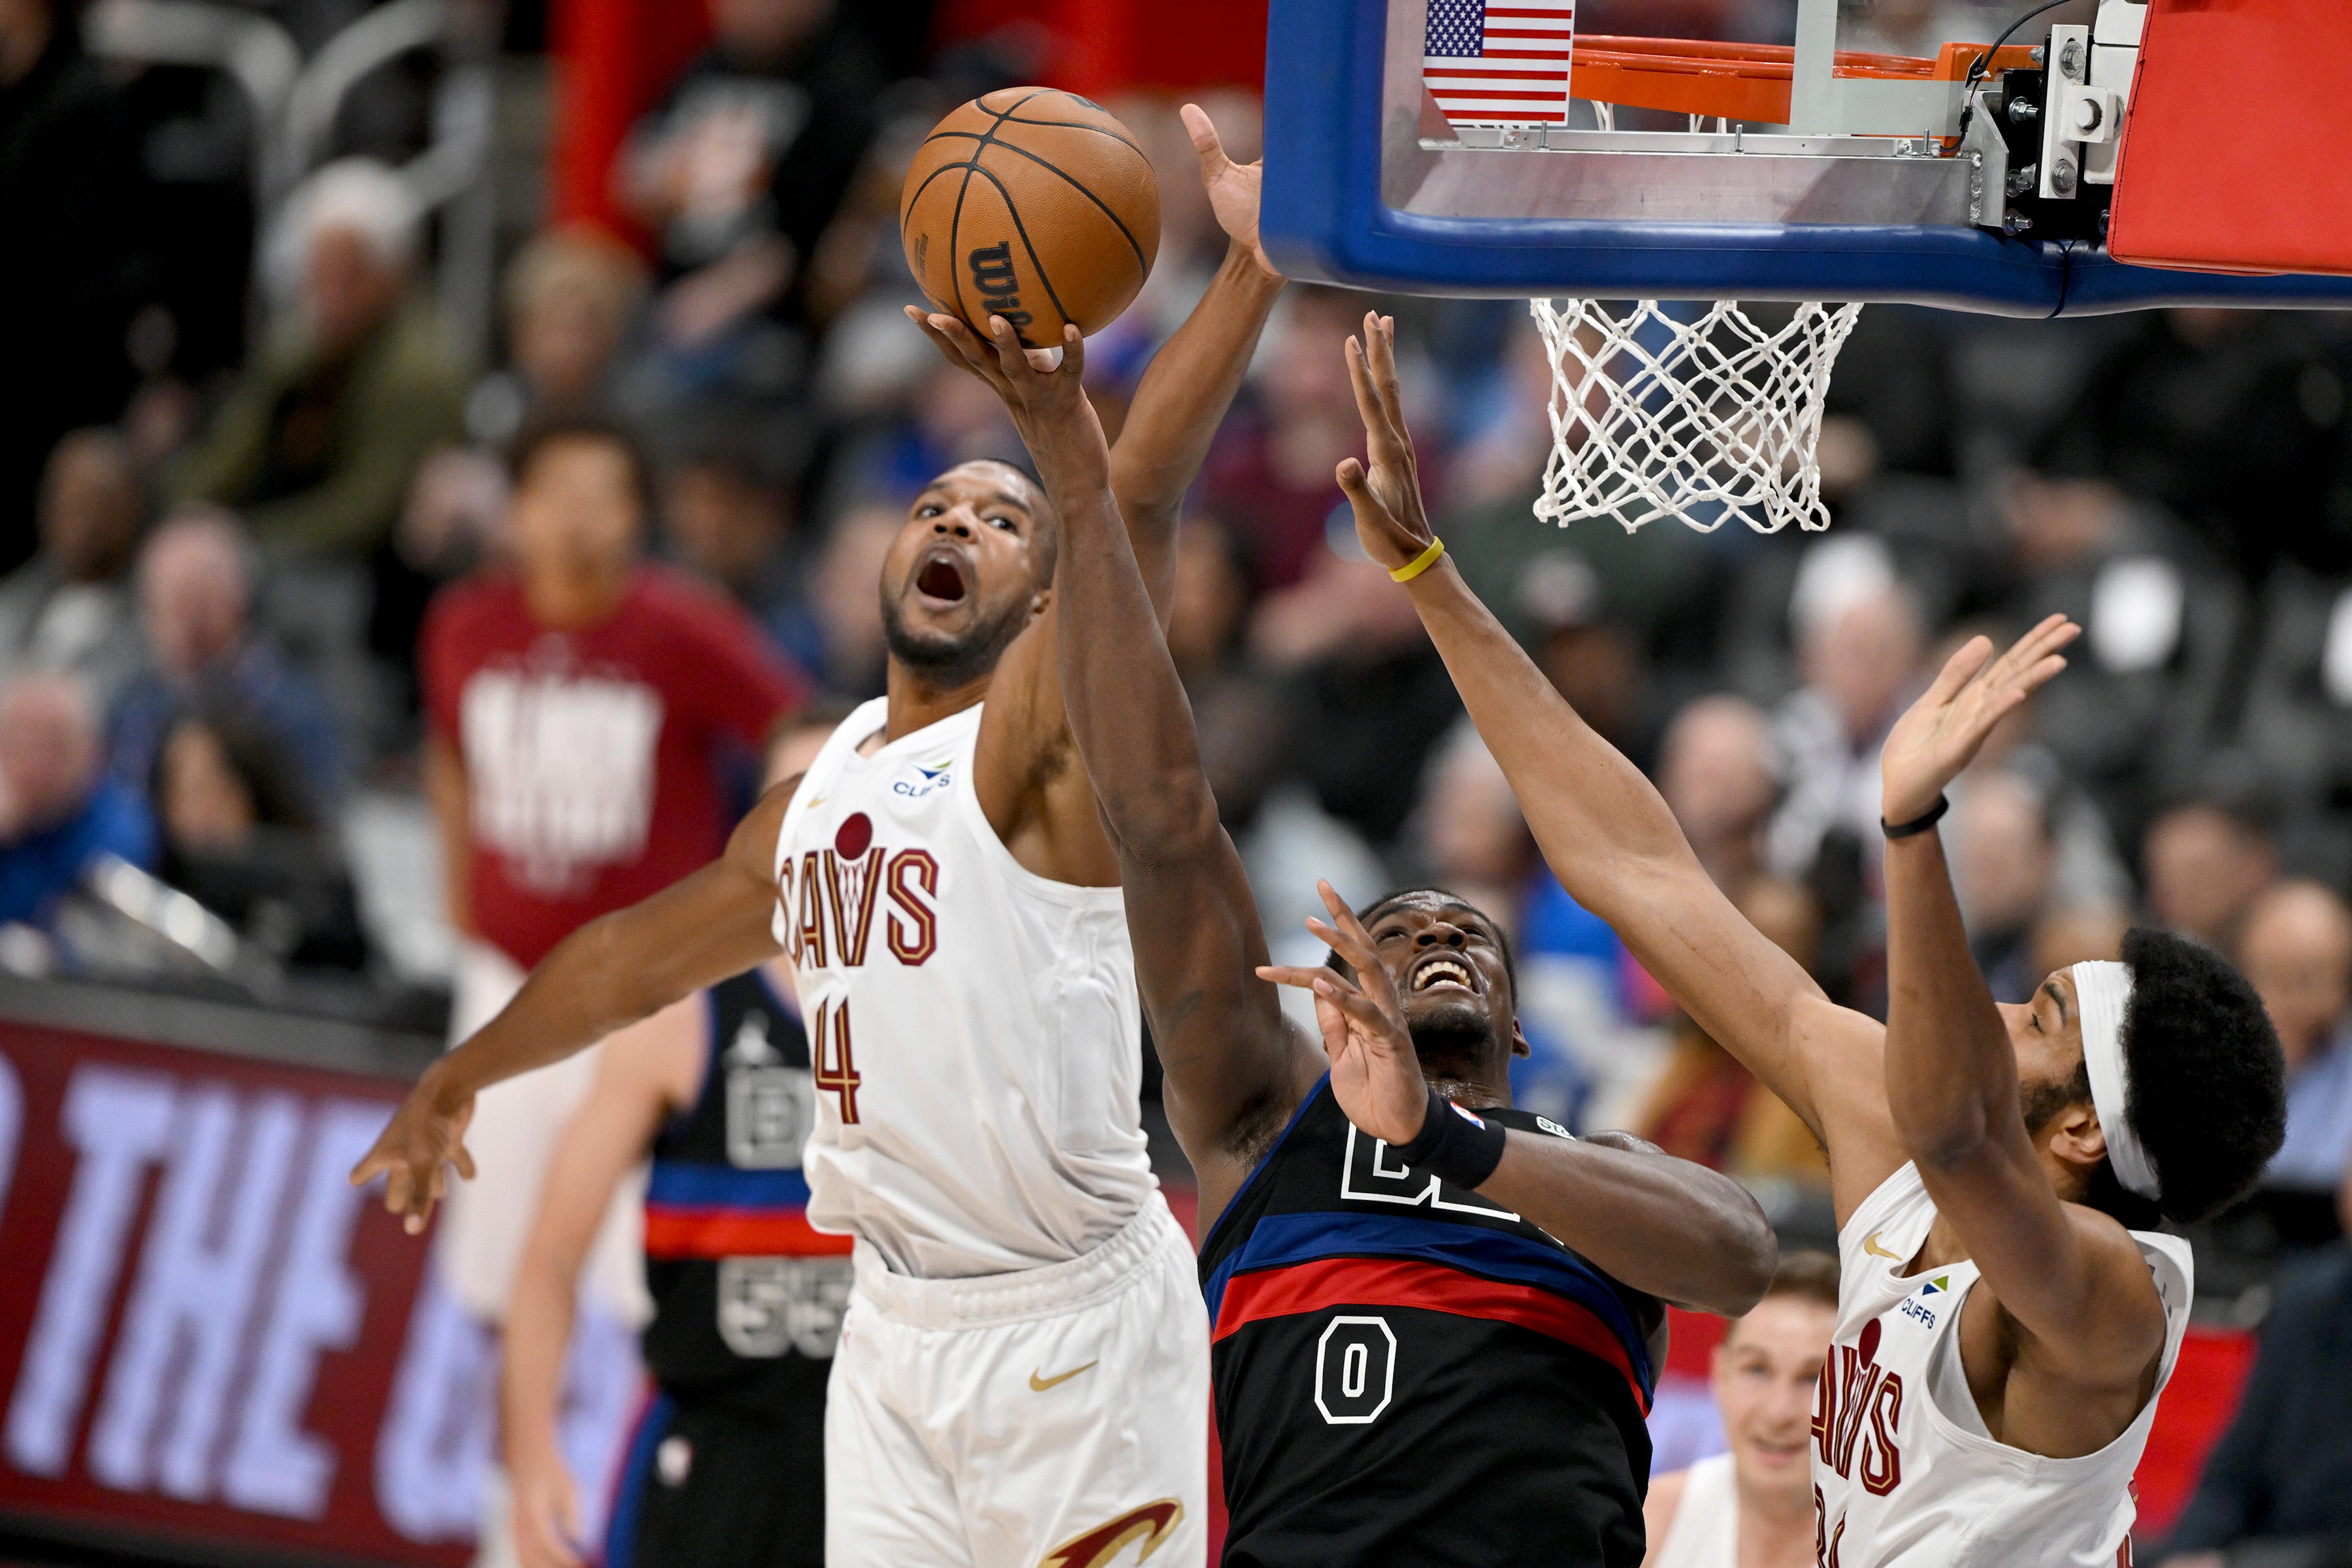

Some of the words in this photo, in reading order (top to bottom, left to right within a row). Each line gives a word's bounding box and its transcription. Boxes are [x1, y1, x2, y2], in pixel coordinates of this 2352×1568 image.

[815, 994, 860, 1124] 4
[3, 1063, 400, 1521] THE
[1902, 1298, 1935, 1330] CLIFFS
[1315, 1316, 1397, 1424] 0
[1810, 1343, 1903, 1496] AVS
